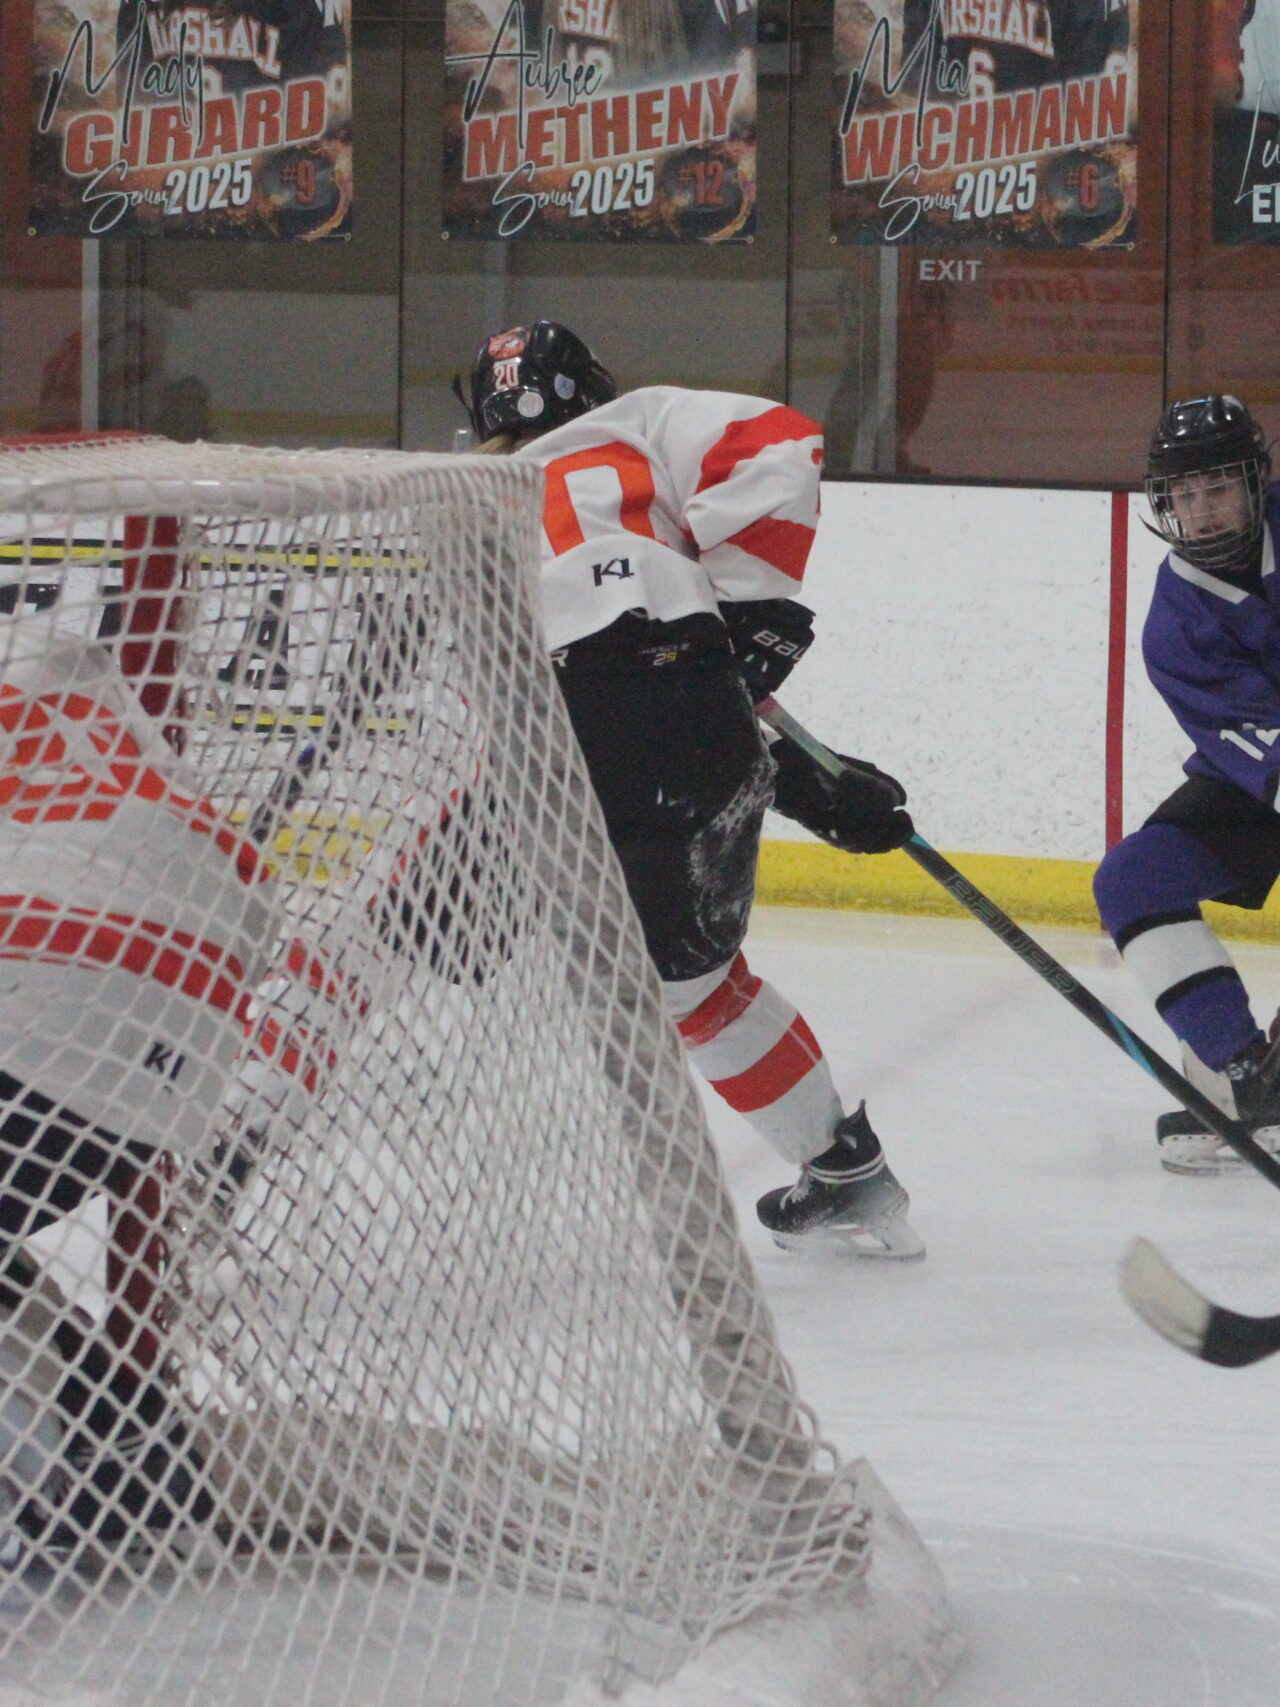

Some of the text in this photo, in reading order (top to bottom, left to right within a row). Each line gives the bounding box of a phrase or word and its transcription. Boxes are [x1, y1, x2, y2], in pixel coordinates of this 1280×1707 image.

[446, 0, 601, 150] Aubree
[841, 0, 969, 148] Mia
[63, 79, 328, 175] GIRARD
[467, 74, 739, 178] METHENY
[845, 73, 1127, 182] WICHMANN
[82, 158, 252, 234] Senior 2025
[492, 159, 655, 236] Senior 2025
[879, 161, 1036, 240] Senior 2025
[919, 260, 981, 281] EXIT
[493, 358, 520, 391] 20
